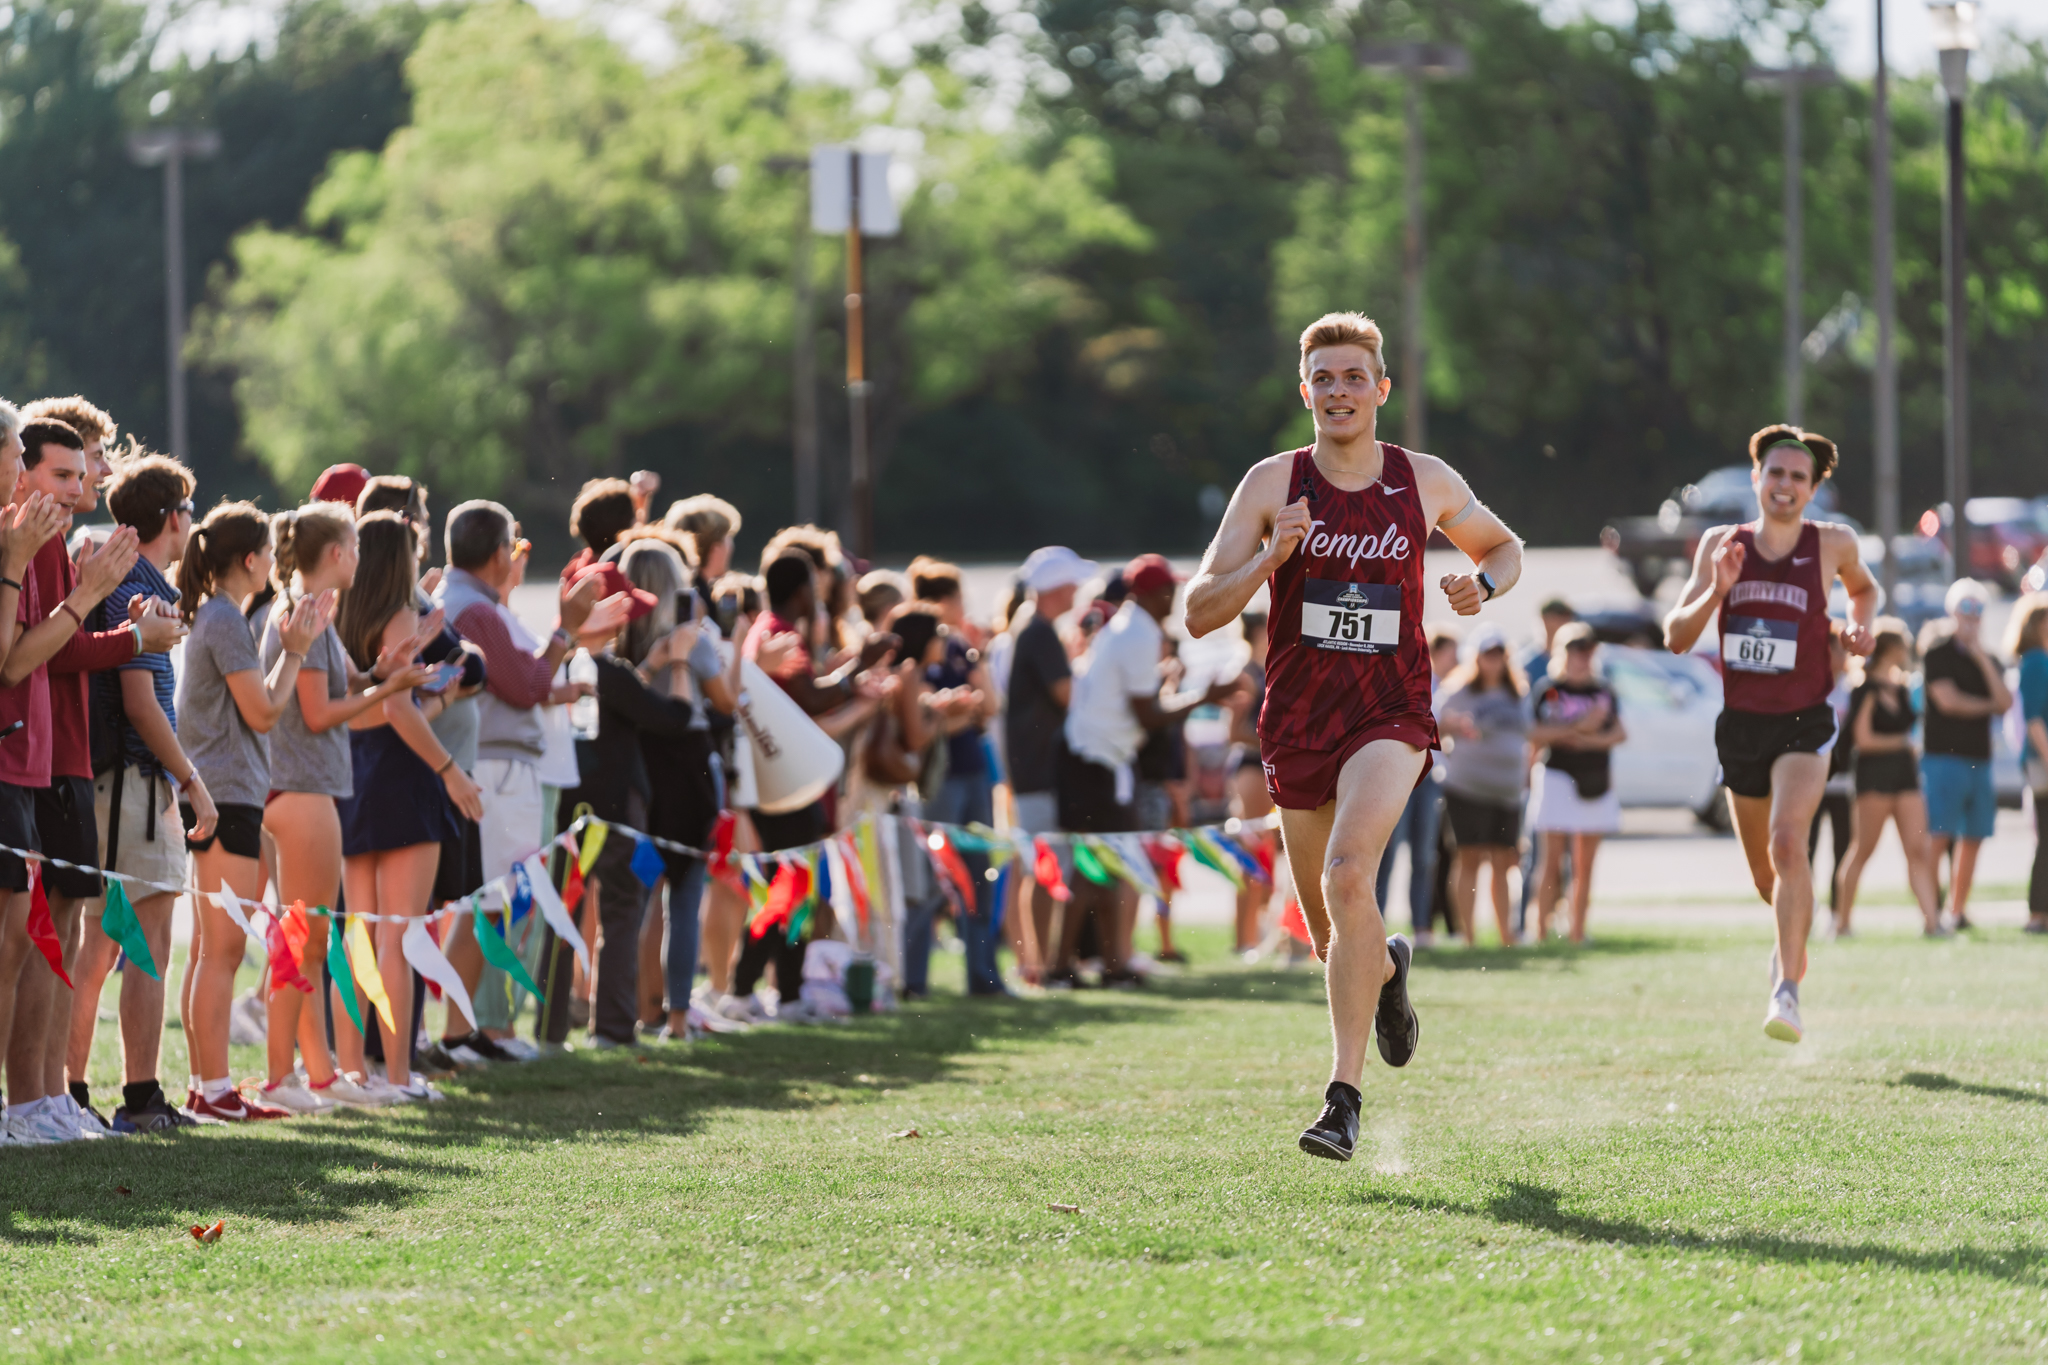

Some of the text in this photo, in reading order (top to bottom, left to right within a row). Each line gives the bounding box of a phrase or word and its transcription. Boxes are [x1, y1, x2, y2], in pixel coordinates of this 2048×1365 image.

[1301, 520, 1409, 569] Temple
[1328, 610, 1372, 641] 751
[1739, 639, 1776, 662] 667
